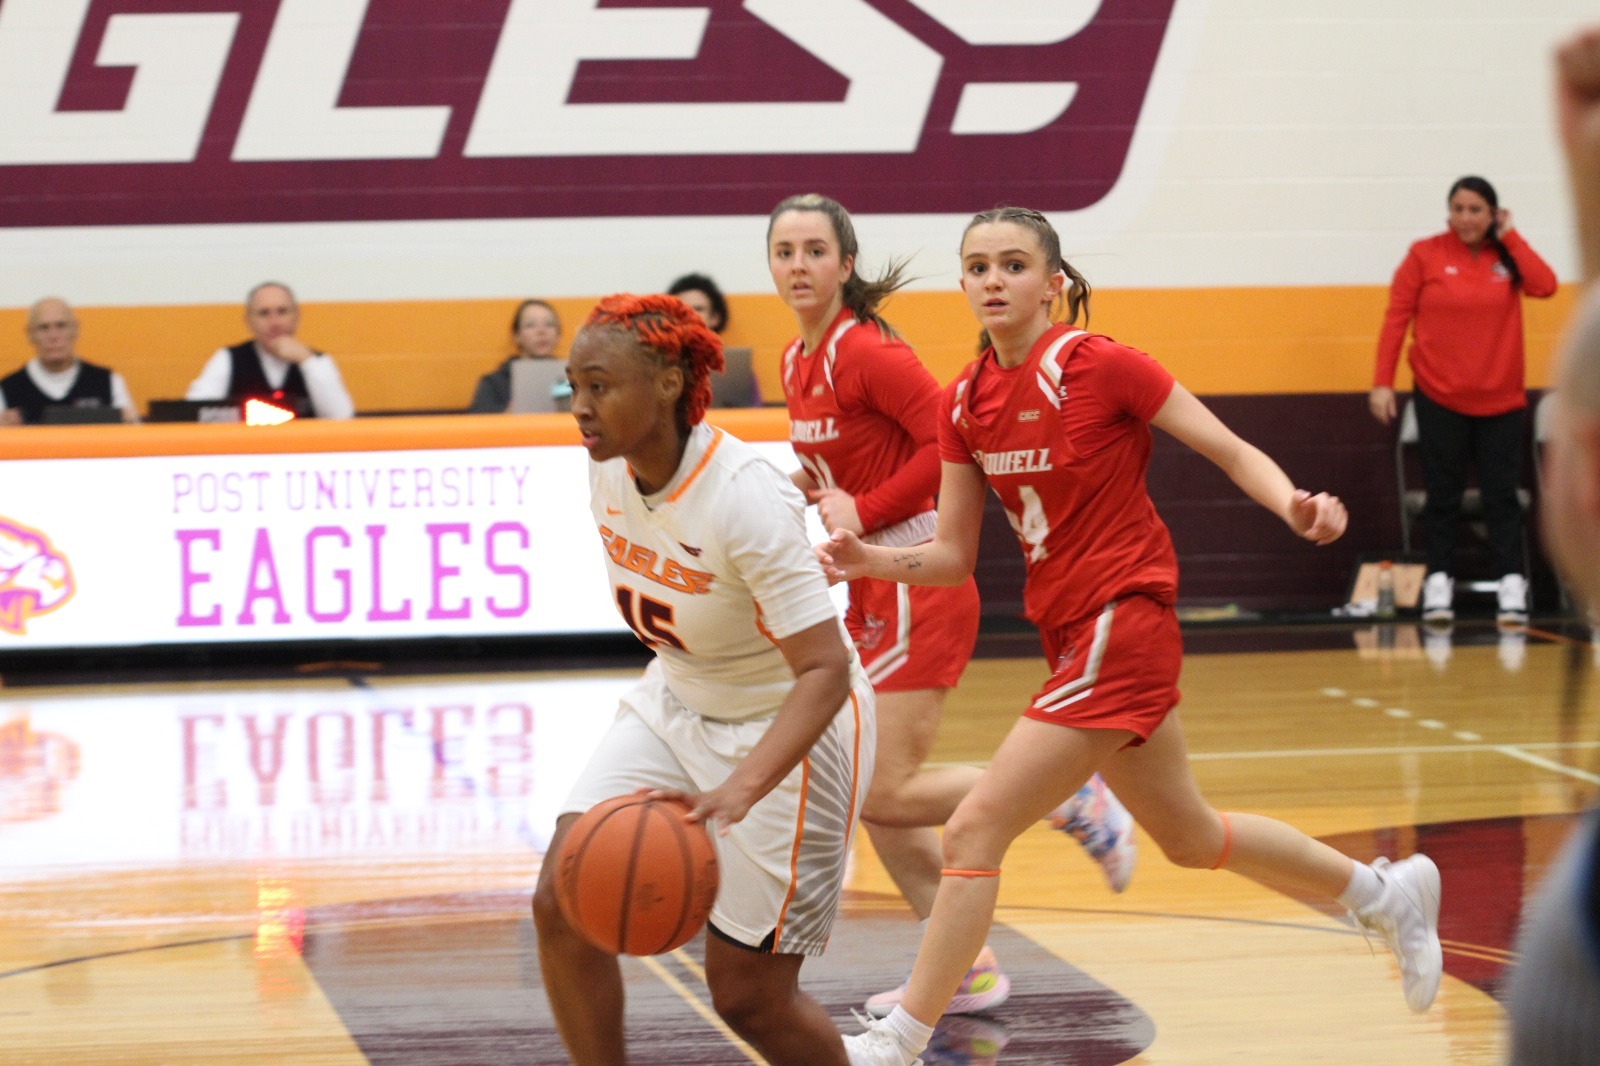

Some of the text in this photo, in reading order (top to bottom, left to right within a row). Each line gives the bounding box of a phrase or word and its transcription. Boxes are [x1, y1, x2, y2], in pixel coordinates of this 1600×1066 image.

[172, 466, 531, 513] POST UNIVERSITY
[175, 521, 531, 627] EAGLES
[616, 584, 690, 654] 15
